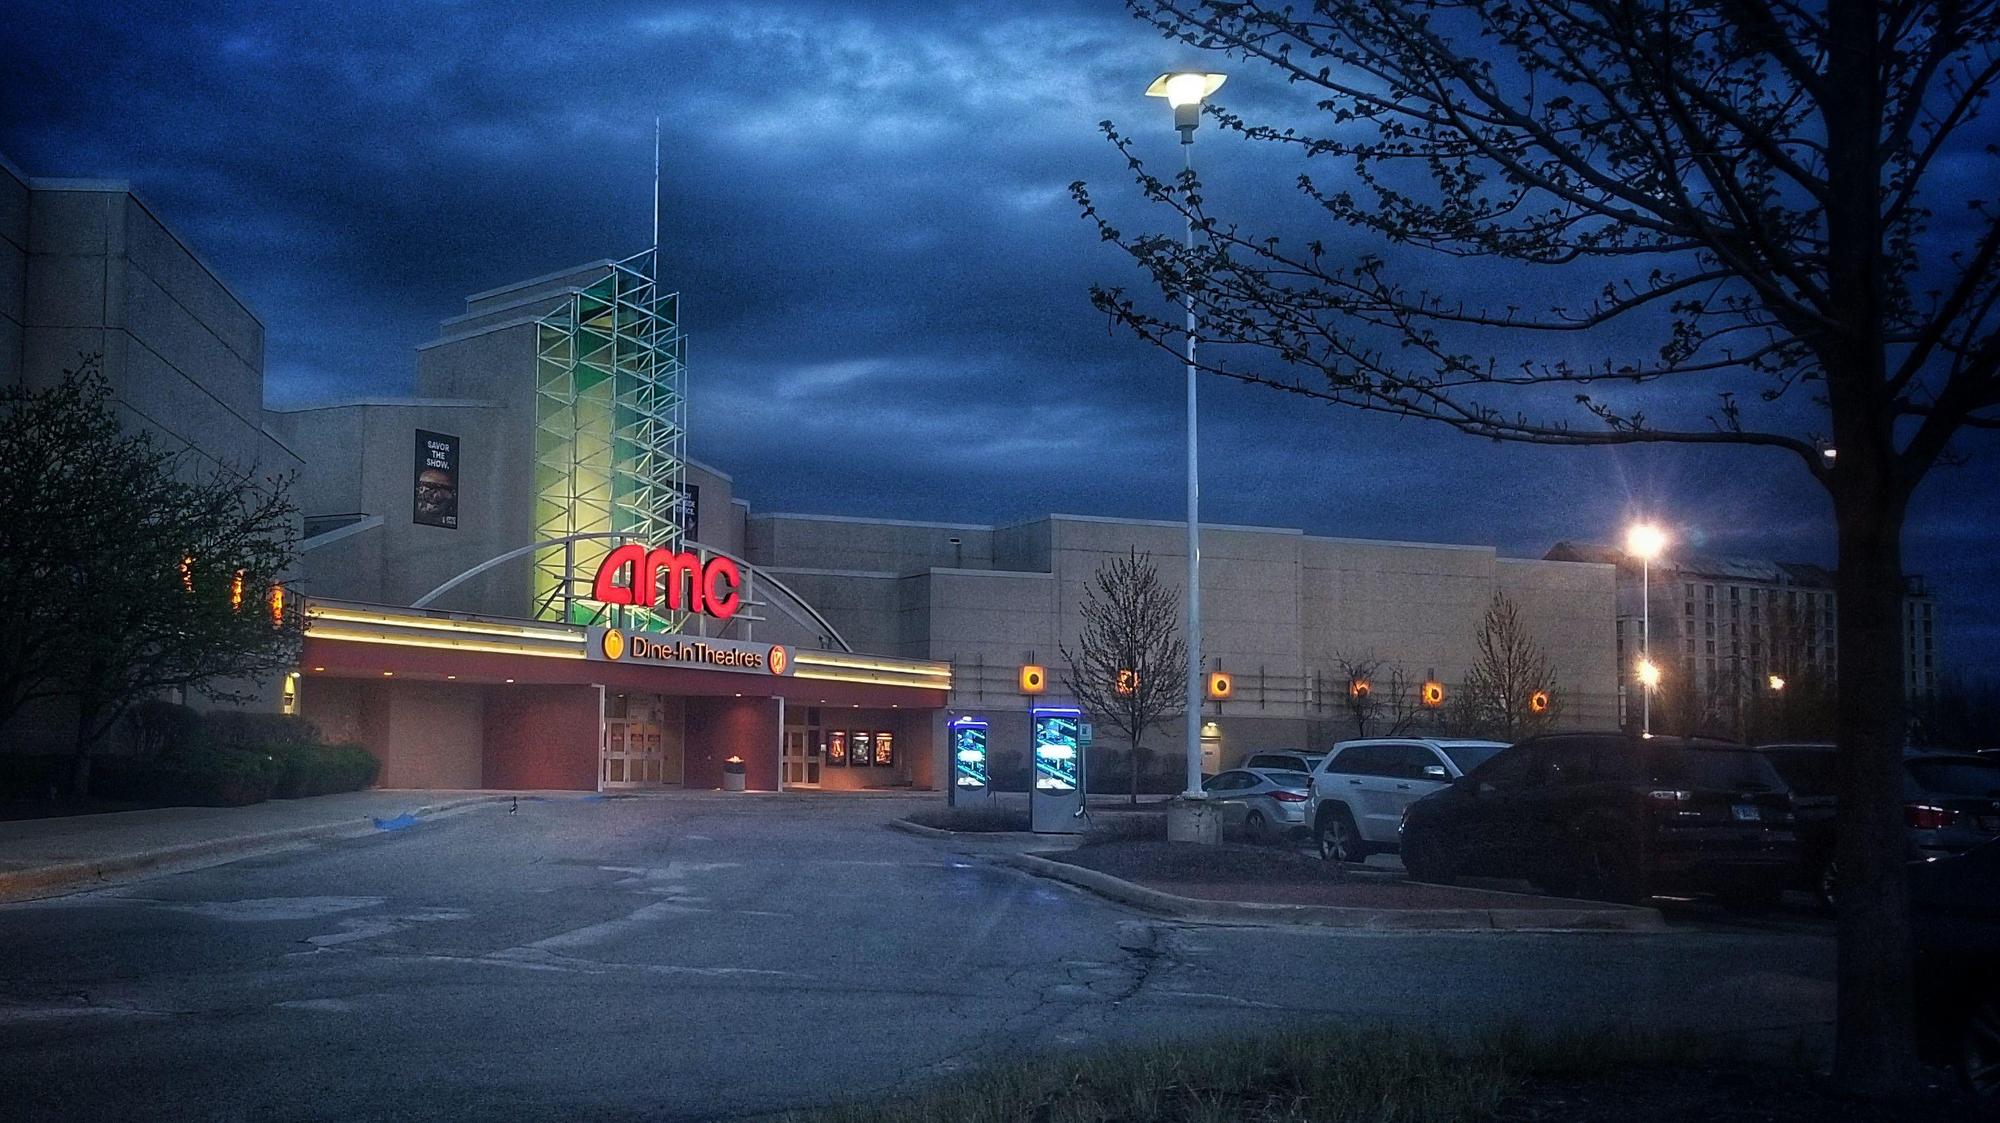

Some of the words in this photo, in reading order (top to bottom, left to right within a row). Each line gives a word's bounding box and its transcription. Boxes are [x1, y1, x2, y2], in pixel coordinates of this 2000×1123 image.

[427, 440, 450, 452] SAVOR
[431, 450, 446, 460] THE
[426, 458, 450, 470] SHOW.
[631, 635, 690, 662] Dine-In
[692, 642, 763, 669] Theatres
